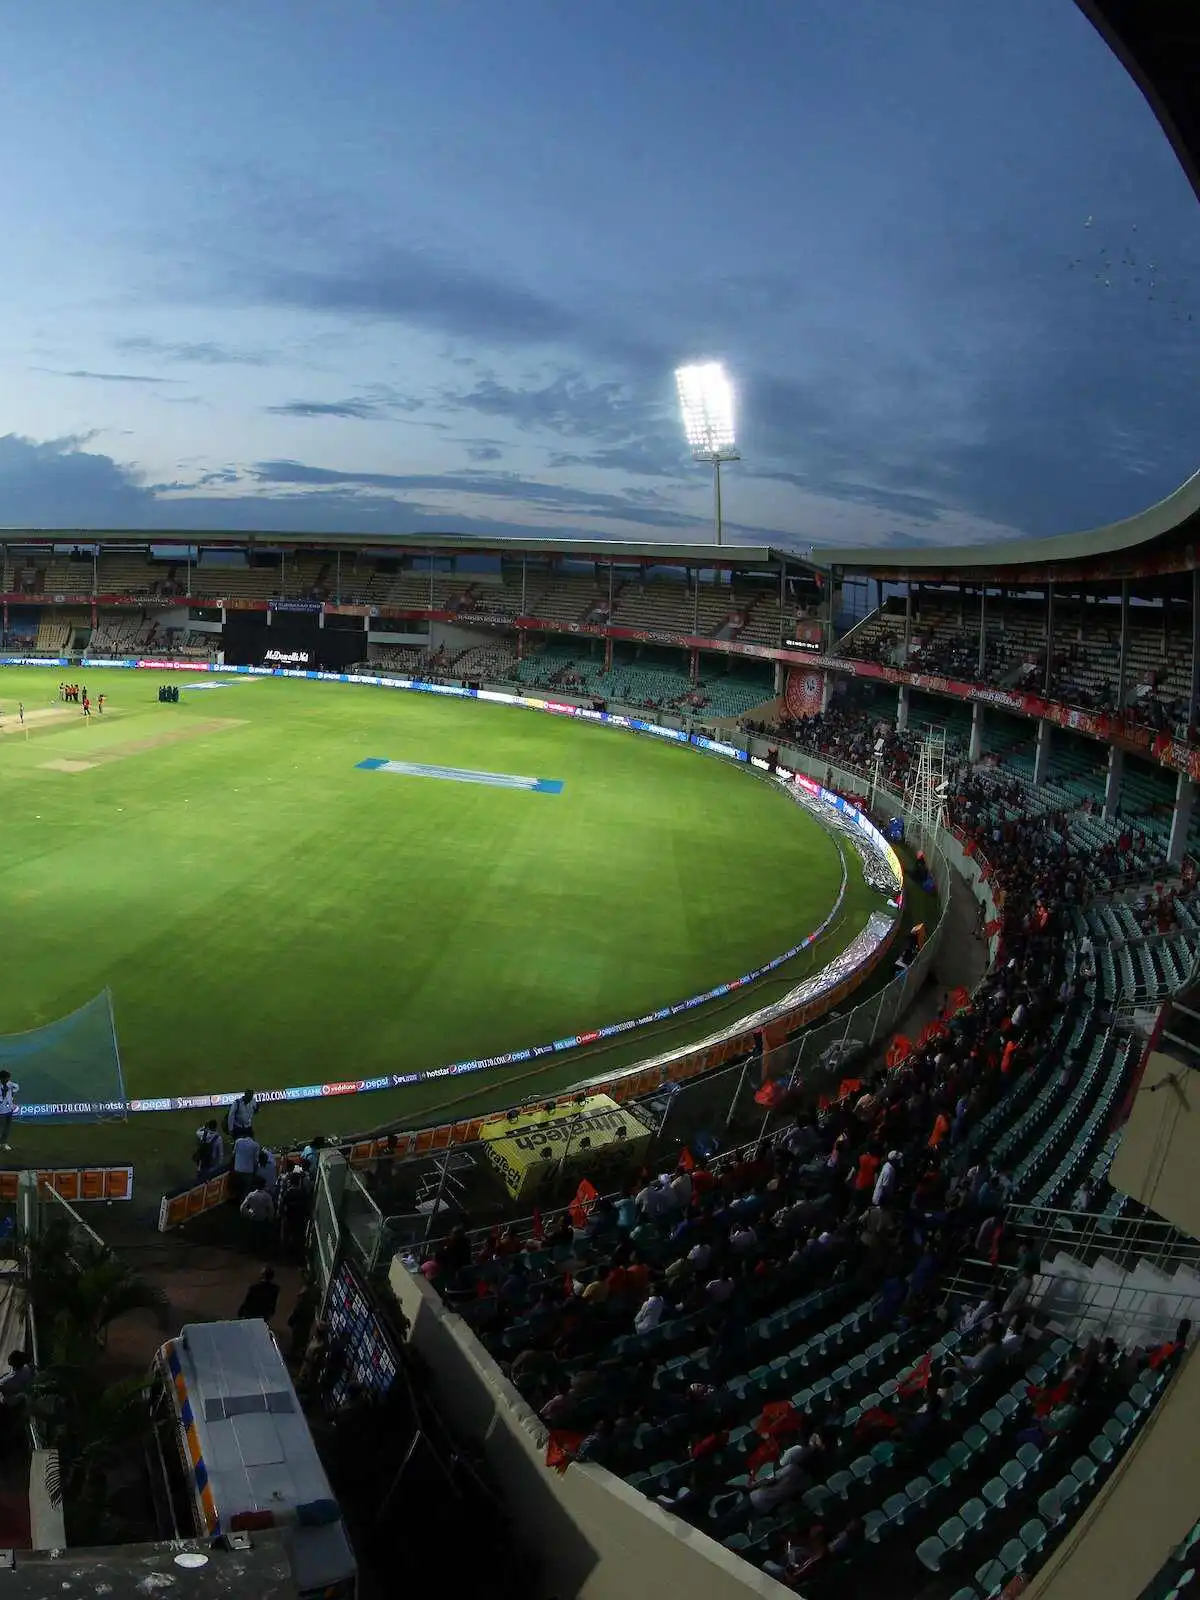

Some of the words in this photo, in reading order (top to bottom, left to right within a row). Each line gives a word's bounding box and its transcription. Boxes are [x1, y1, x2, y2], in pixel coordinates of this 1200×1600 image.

[324, 672, 340, 680] pepsi
[512, 1049, 530, 1061] pepsi
[458, 1060, 477, 1072] pepsi
[477, 1056, 505, 1069] IPLT20.COM
[426, 1067, 450, 1078] hotstar
[366, 1077, 389, 1089] pepsi
[287, 1088, 300, 1098] YES
[303, 1087, 322, 1097] BANK
[20, 1104, 48, 1114] pepsi
[50, 1103, 91, 1112] IPLT20.COM
[143, 1100, 170, 1110] pepsi
